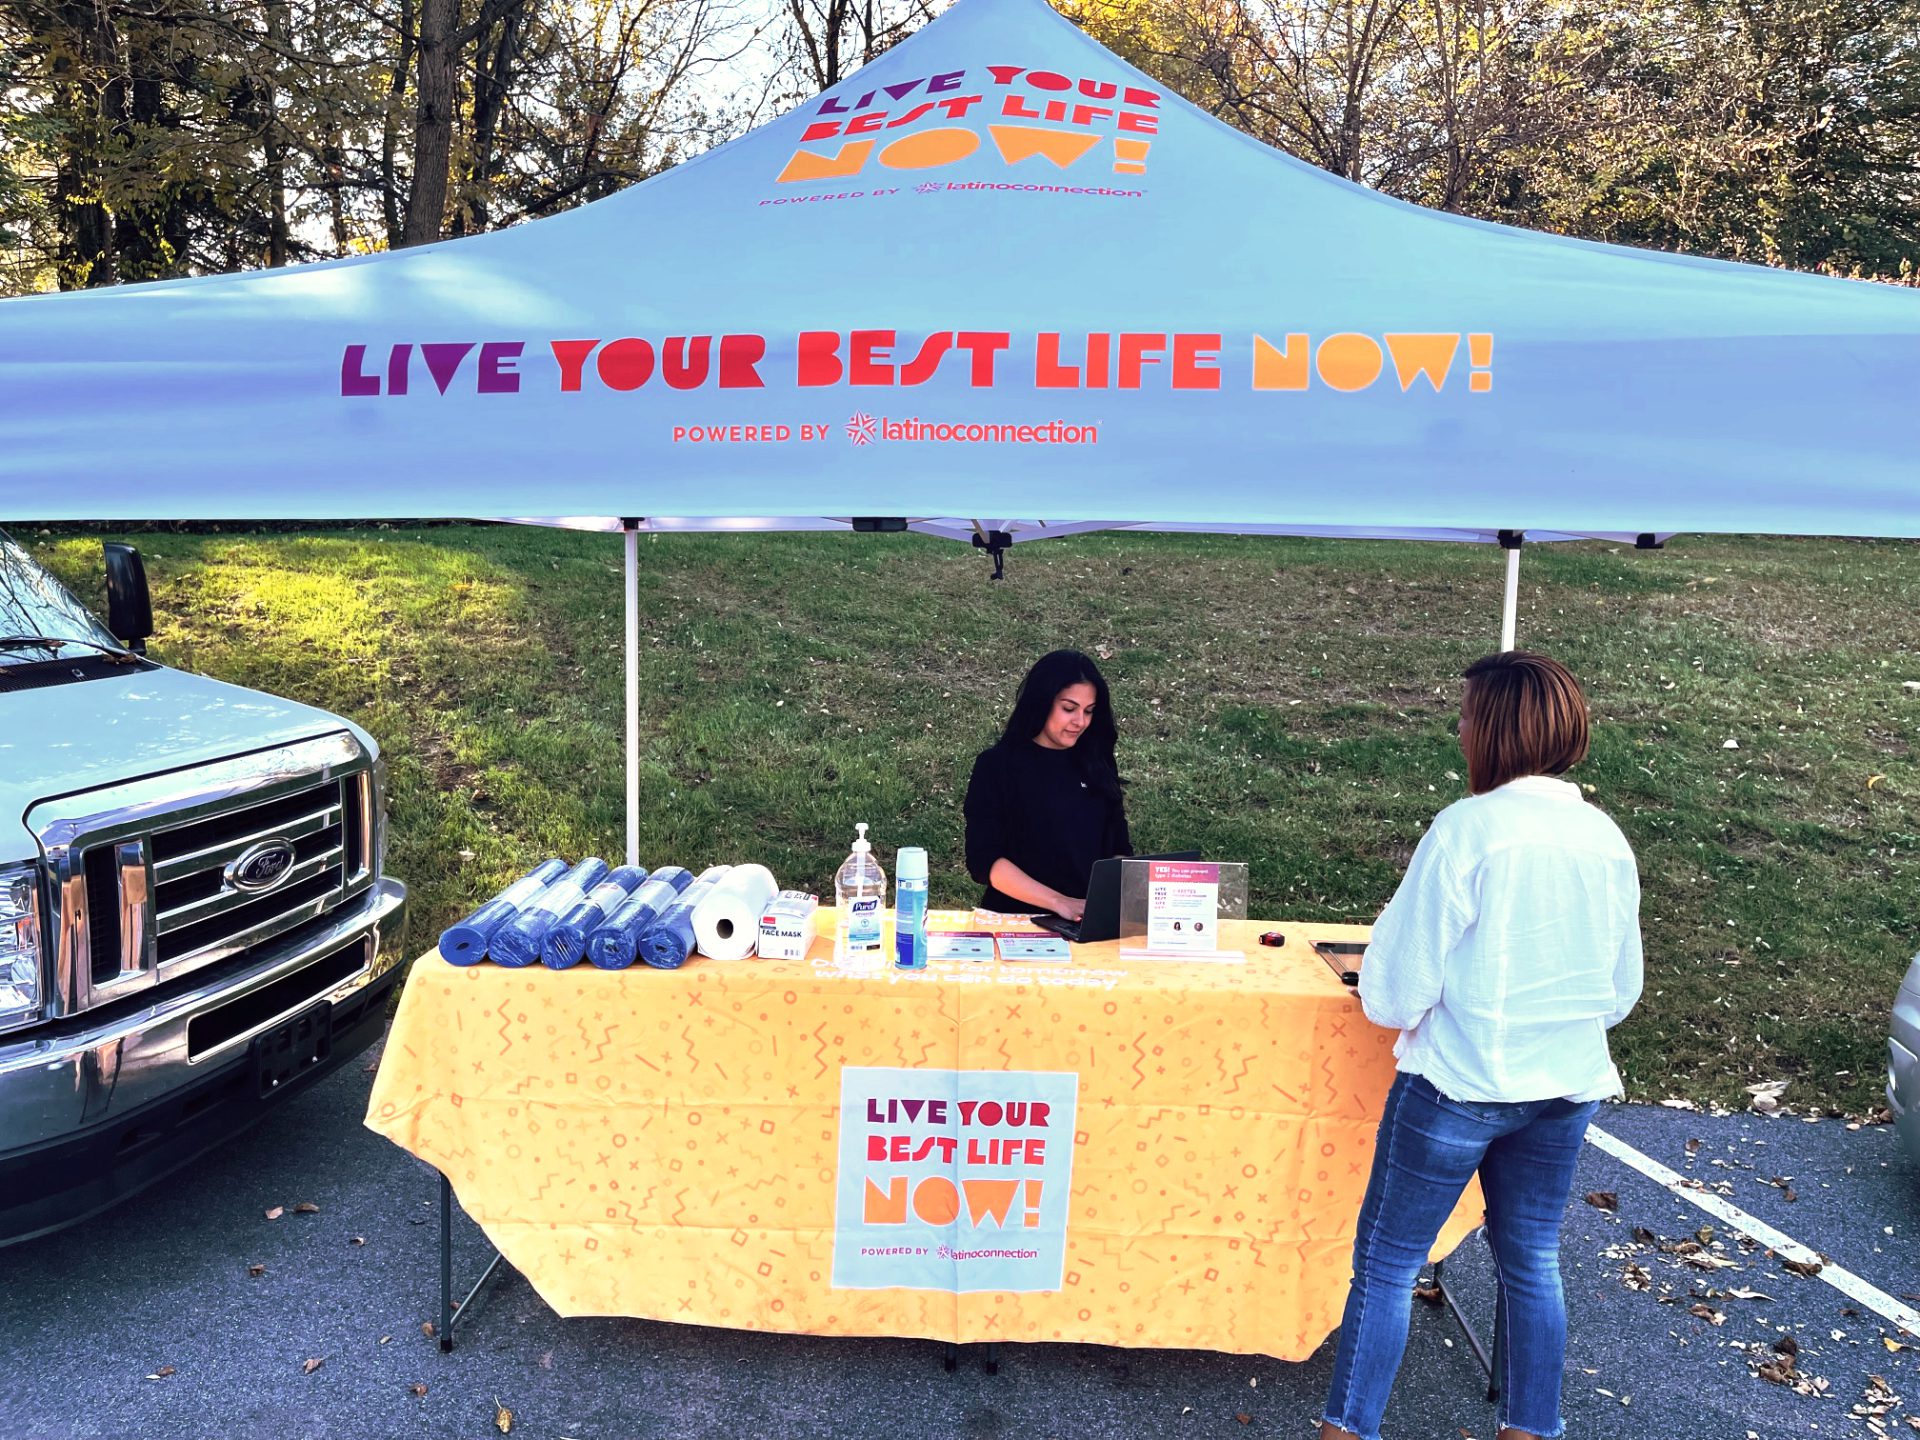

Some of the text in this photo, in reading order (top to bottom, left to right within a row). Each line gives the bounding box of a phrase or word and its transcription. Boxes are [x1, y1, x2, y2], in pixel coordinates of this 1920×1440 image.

[816, 65, 1161, 115] LIVE YOUR
[799, 95, 1160, 142] BEST LIFE
[775, 125, 1152, 184] NOW!
[758, 181, 1143, 207] POWERED BY latinoconnection
[340, 329, 1495, 398] LIVE YOUR BEST LIFE NOW!
[673, 417, 1098, 444] POWERED BY latinoconnection
[255, 853, 285, 880] Ford
[762, 929, 803, 938] FACE MASK
[887, 971, 938, 986] you
[1038, 975, 1119, 991] today
[999, 965, 1129, 977] tomorrow
[866, 1098, 1051, 1127] LIVE YOUR
[866, 1135, 1046, 1165] BEST LIFE
[863, 1175, 1044, 1230] NOW!
[861, 1246, 1038, 1261] POWERED BY latinoconnection
